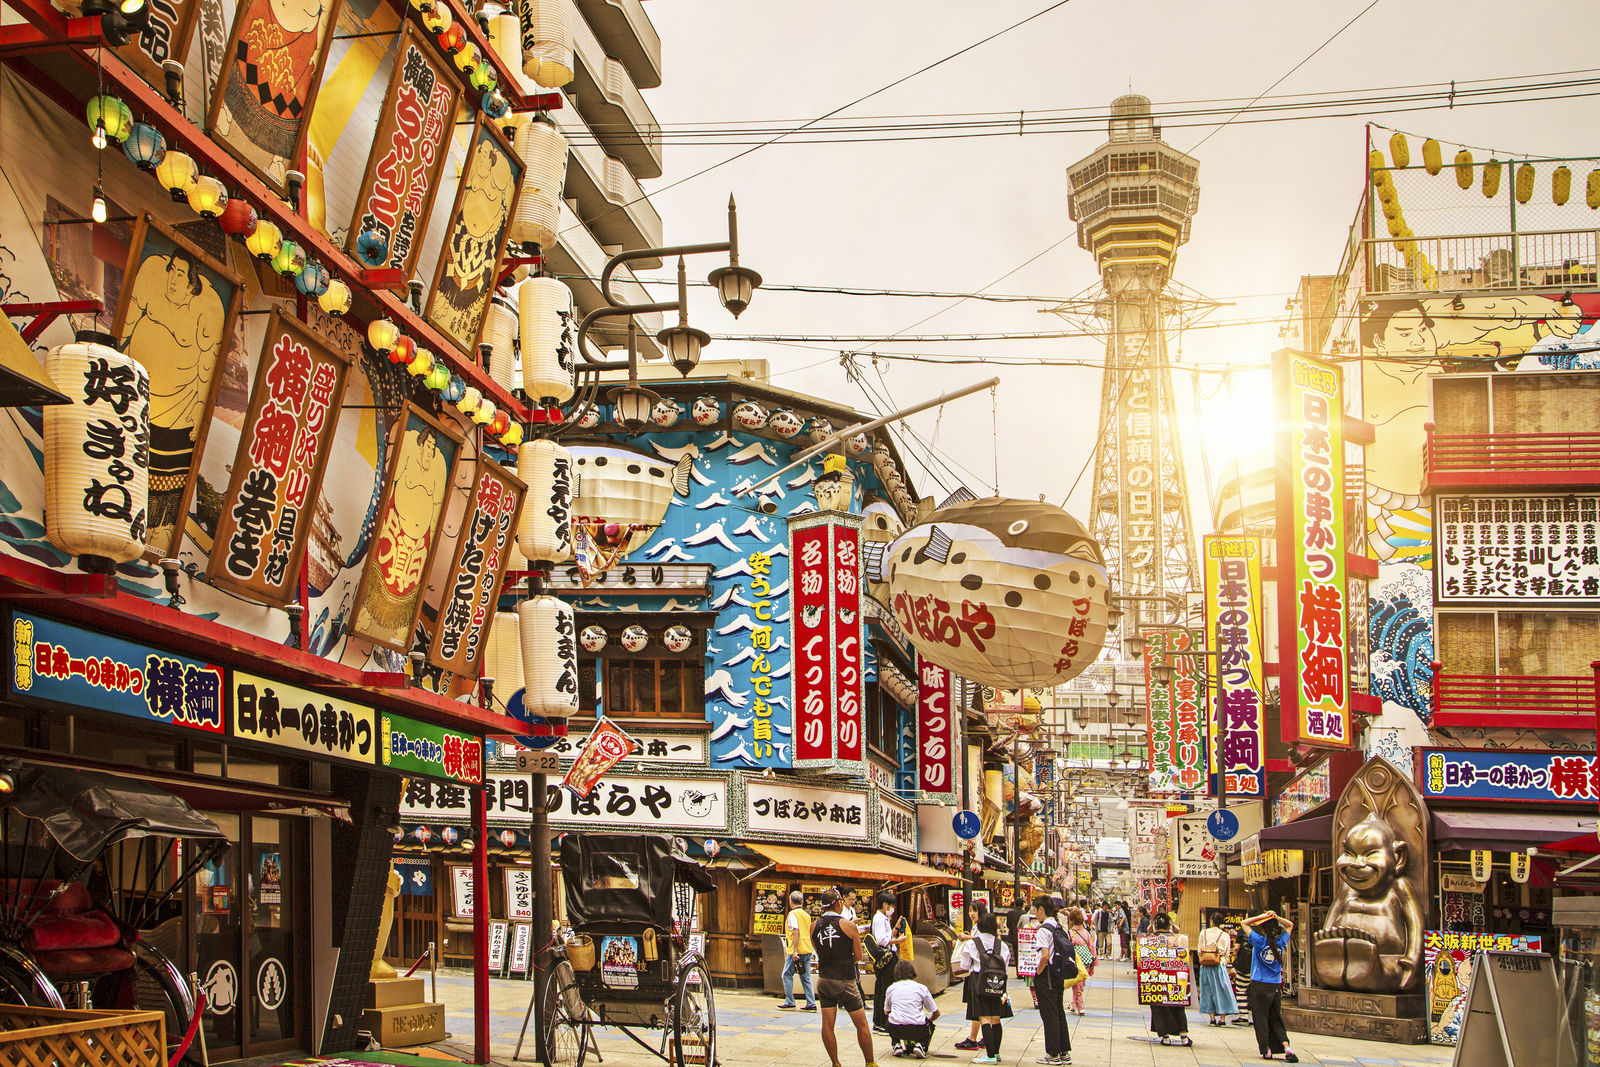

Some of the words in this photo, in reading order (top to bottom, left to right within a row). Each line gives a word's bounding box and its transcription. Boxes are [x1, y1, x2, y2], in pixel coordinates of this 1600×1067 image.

[1302, 394, 1335, 578] 日本一の串かつ
[441, 473, 504, 660] 揚げたこ焼き
[801, 540, 824, 596] 名物
[836, 540, 858, 597] 名物
[1445, 546, 1459, 596] もち
[1462, 546, 1478, 596] うずら玉子
[1478, 546, 1496, 596] 紅しょうが
[1495, 546, 1512, 596] にんにく
[1512, 546, 1529, 596] 玉ねぎ
[1529, 546, 1546, 596] 山芋
[1547, 546, 1564, 596] しし唐
[1564, 546, 1581, 596] れんこん
[1581, 546, 1599, 596] 銀杏
[893, 589, 996, 653] づぼらや
[1053, 596, 1093, 673] づぼらや
[1218, 561, 1250, 685] 日本一の串かつ
[1300, 581, 1344, 706] 横綱
[14, 618, 34, 690] 新世界
[35, 644, 144, 695] 日本一の串かつ
[145, 657, 223, 728] 横綱
[802, 636, 825, 749] てっちり
[836, 636, 859, 750] てっちり
[237, 684, 372, 756] 日本一の串かつ
[922, 652, 947, 787] 味てっちり
[1214, 689, 1259, 771] 横綱
[1308, 710, 1344, 738] 酒処
[391, 732, 443, 763] 日本一の串かつ
[442, 735, 481, 783] 横綱
[1446, 763, 1547, 788] 日本一の串かつ
[1549, 757, 1599, 798] 横
[752, 797, 862, 827] づぼらや本店
[1427, 932, 1514, 952] 大阪新世界
[1308, 992, 1384, 1016] BILLIKEN
